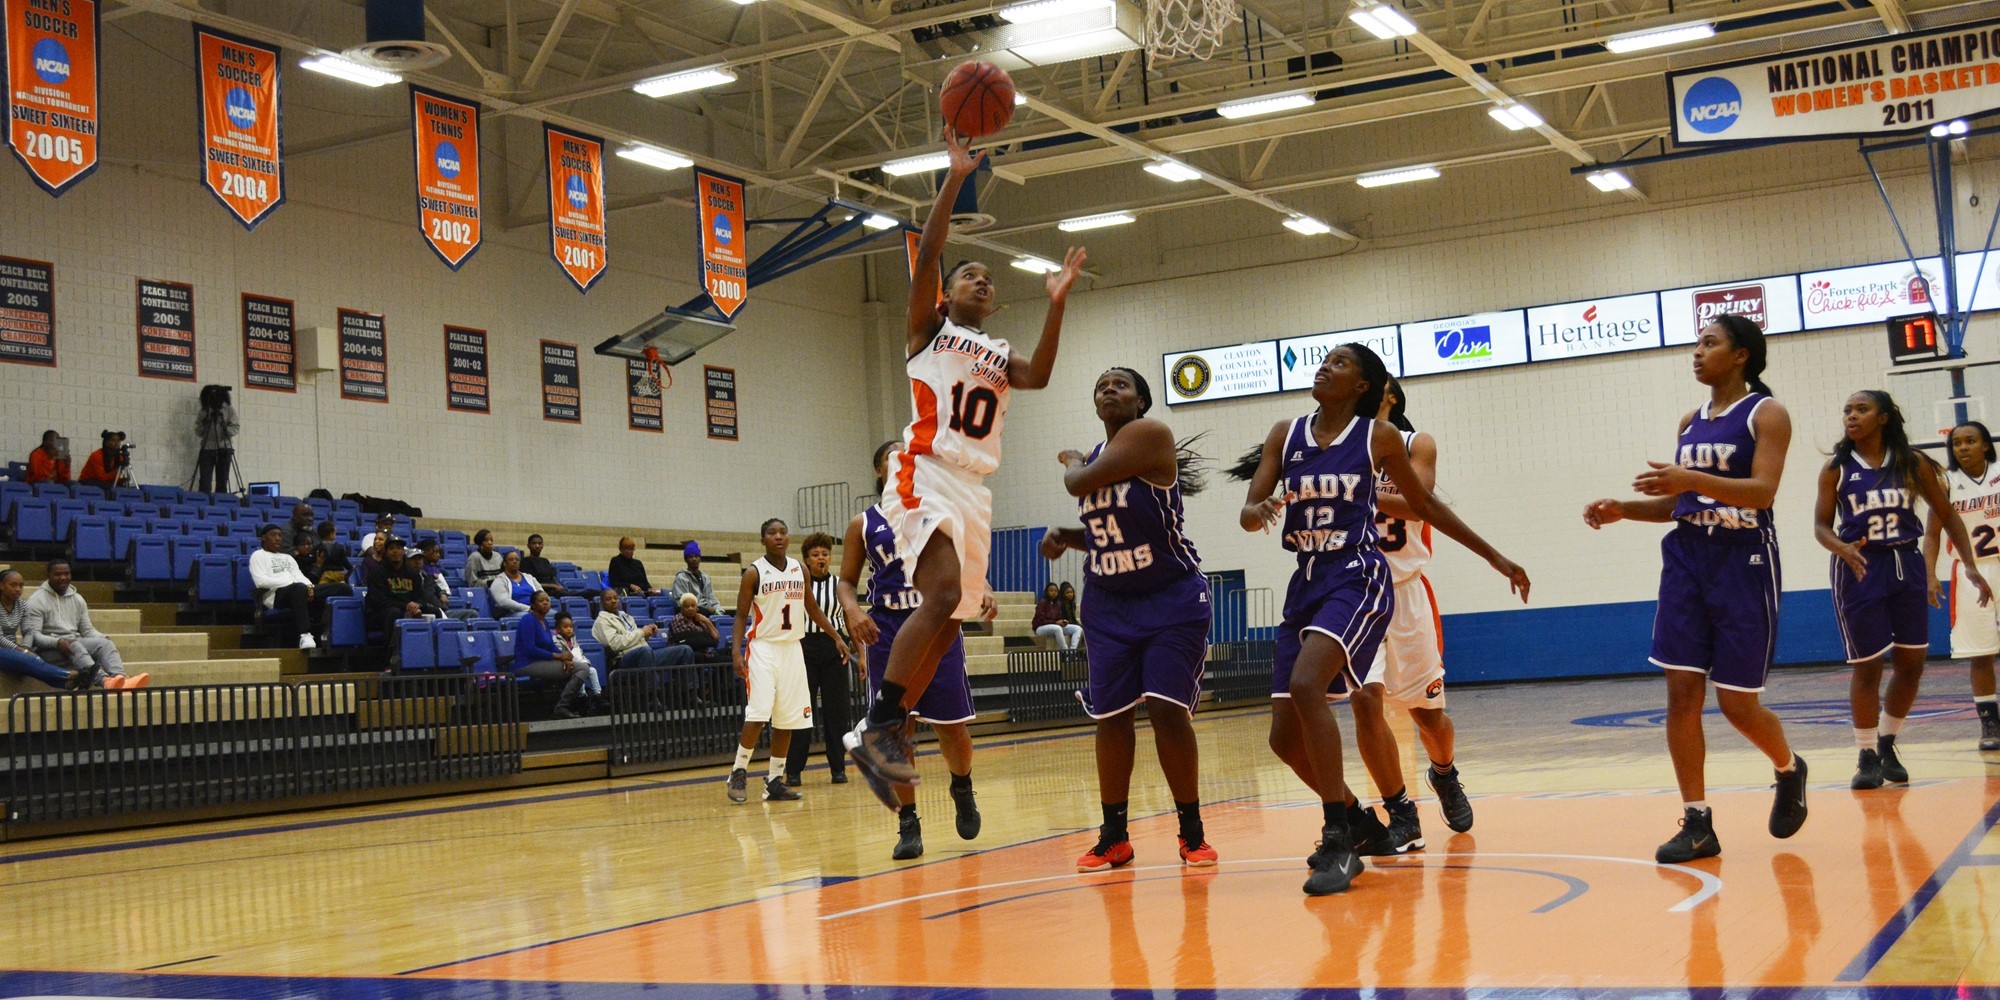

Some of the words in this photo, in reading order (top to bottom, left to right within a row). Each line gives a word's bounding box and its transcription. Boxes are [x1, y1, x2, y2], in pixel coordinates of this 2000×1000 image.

[25, 10, 78, 39] SOCCER
[222, 46, 256, 67] MEN'S
[36, 58, 70, 77] NCAA
[217, 63, 262, 87] SOCCER
[1767, 51, 1883, 93] NATIONAL
[1771, 81, 1886, 117] WOMEN'S
[12, 104, 48, 125] SWEET
[51, 112, 95, 135] SIXTEEN
[229, 105, 256, 121] NCAA
[425, 101, 467, 124] WOMEN'S
[1689, 101, 1740, 123] NCAA
[1882, 98, 1935, 126] 2011
[431, 119, 463, 140] TENNIS
[26, 130, 83, 165] 2005
[564, 140, 587, 157] MEN'S
[209, 147, 240, 166] SWEET
[242, 155, 276, 176] SIXTEEN
[438, 157, 460, 172] NCAA
[561, 154, 592, 173] SOCCER
[222, 170, 268, 203] 2004
[711, 181, 730, 197] MEN'S
[421, 197, 447, 213] SWEET
[449, 203, 478, 219] SIXTEEN
[708, 195, 735, 212] SOCCER
[433, 218, 471, 245] 2002
[555, 226, 577, 241] SWEET
[579, 231, 603, 247] SIXTEEN
[716, 227, 732, 240] NCAA
[565, 245, 595, 270] 2001
[0, 265, 23, 277] EACH
[27, 268, 47, 280] BELT
[0, 277, 49, 292] ONFERENCE
[142, 285, 167, 297] PEACH
[170, 289, 187, 300] BELT
[712, 278, 740, 301] 2000
[1829, 284, 1866, 298] Forest
[1870, 280, 1898, 293] Park
[7, 292, 39, 307] 2005
[142, 297, 189, 311] CONFERENCE
[248, 301, 270, 313] PEACH
[272, 305, 288, 316] BELT
[1697, 298, 1761, 319] DRURY
[1807, 288, 1897, 314] Chick-fil-A
[153, 312, 180, 326] 2005
[248, 313, 290, 327] CONFERENCE
[343, 316, 363, 327] PEACH
[365, 320, 380, 329] BELT
[1433, 318, 1476, 330] GEORGIA'S
[142, 325, 192, 341] CONFERENCE
[249, 326, 290, 341] 2004-05
[343, 327, 382, 340] CONFERENCE
[449, 332, 468, 342] PEACH
[469, 335, 482, 345] BELT
[1538, 317, 1652, 346] Heritage
[1904, 318, 1935, 349] 17
[0, 344, 26, 354] OMEN'S
[343, 342, 383, 357] 2004-05
[449, 342, 484, 354] CONFERENCE
[544, 346, 561, 356] PEACH
[562, 349, 574, 358] BELT
[1436, 328, 1492, 360] Own
[1567, 339, 1617, 352] BANK
[453, 357, 481, 370] 2001-02
[544, 356, 576, 367] CONFERENCE
[630, 359, 645, 369] PEACH
[1224, 348, 1261, 361] CLAYTON
[1256, 358, 1268, 367] GA
[142, 360, 169, 370] WOMEN'S
[171, 363, 193, 373] SOCCER
[1214, 367, 1274, 383] DEVELOPMENT
[554, 374, 569, 384] 2001
[707, 379, 734, 389] CONFERENCE
[1222, 380, 1268, 392] AUTHORITY
[948, 379, 999, 441] 10
[1679, 442, 1737, 472] ADY
[1284, 473, 1361, 505] LADY
[1078, 481, 1132, 517] ADY
[1847, 487, 1912, 517] LADY
[1304, 505, 1335, 530] 12
[1867, 512, 1900, 541] 22
[1088, 514, 1124, 548] 54
[1971, 523, 2000, 558] 2
[1089, 543, 1154, 577] LONS
[882, 589, 923, 609] LIO
[781, 603, 792, 631] 1
